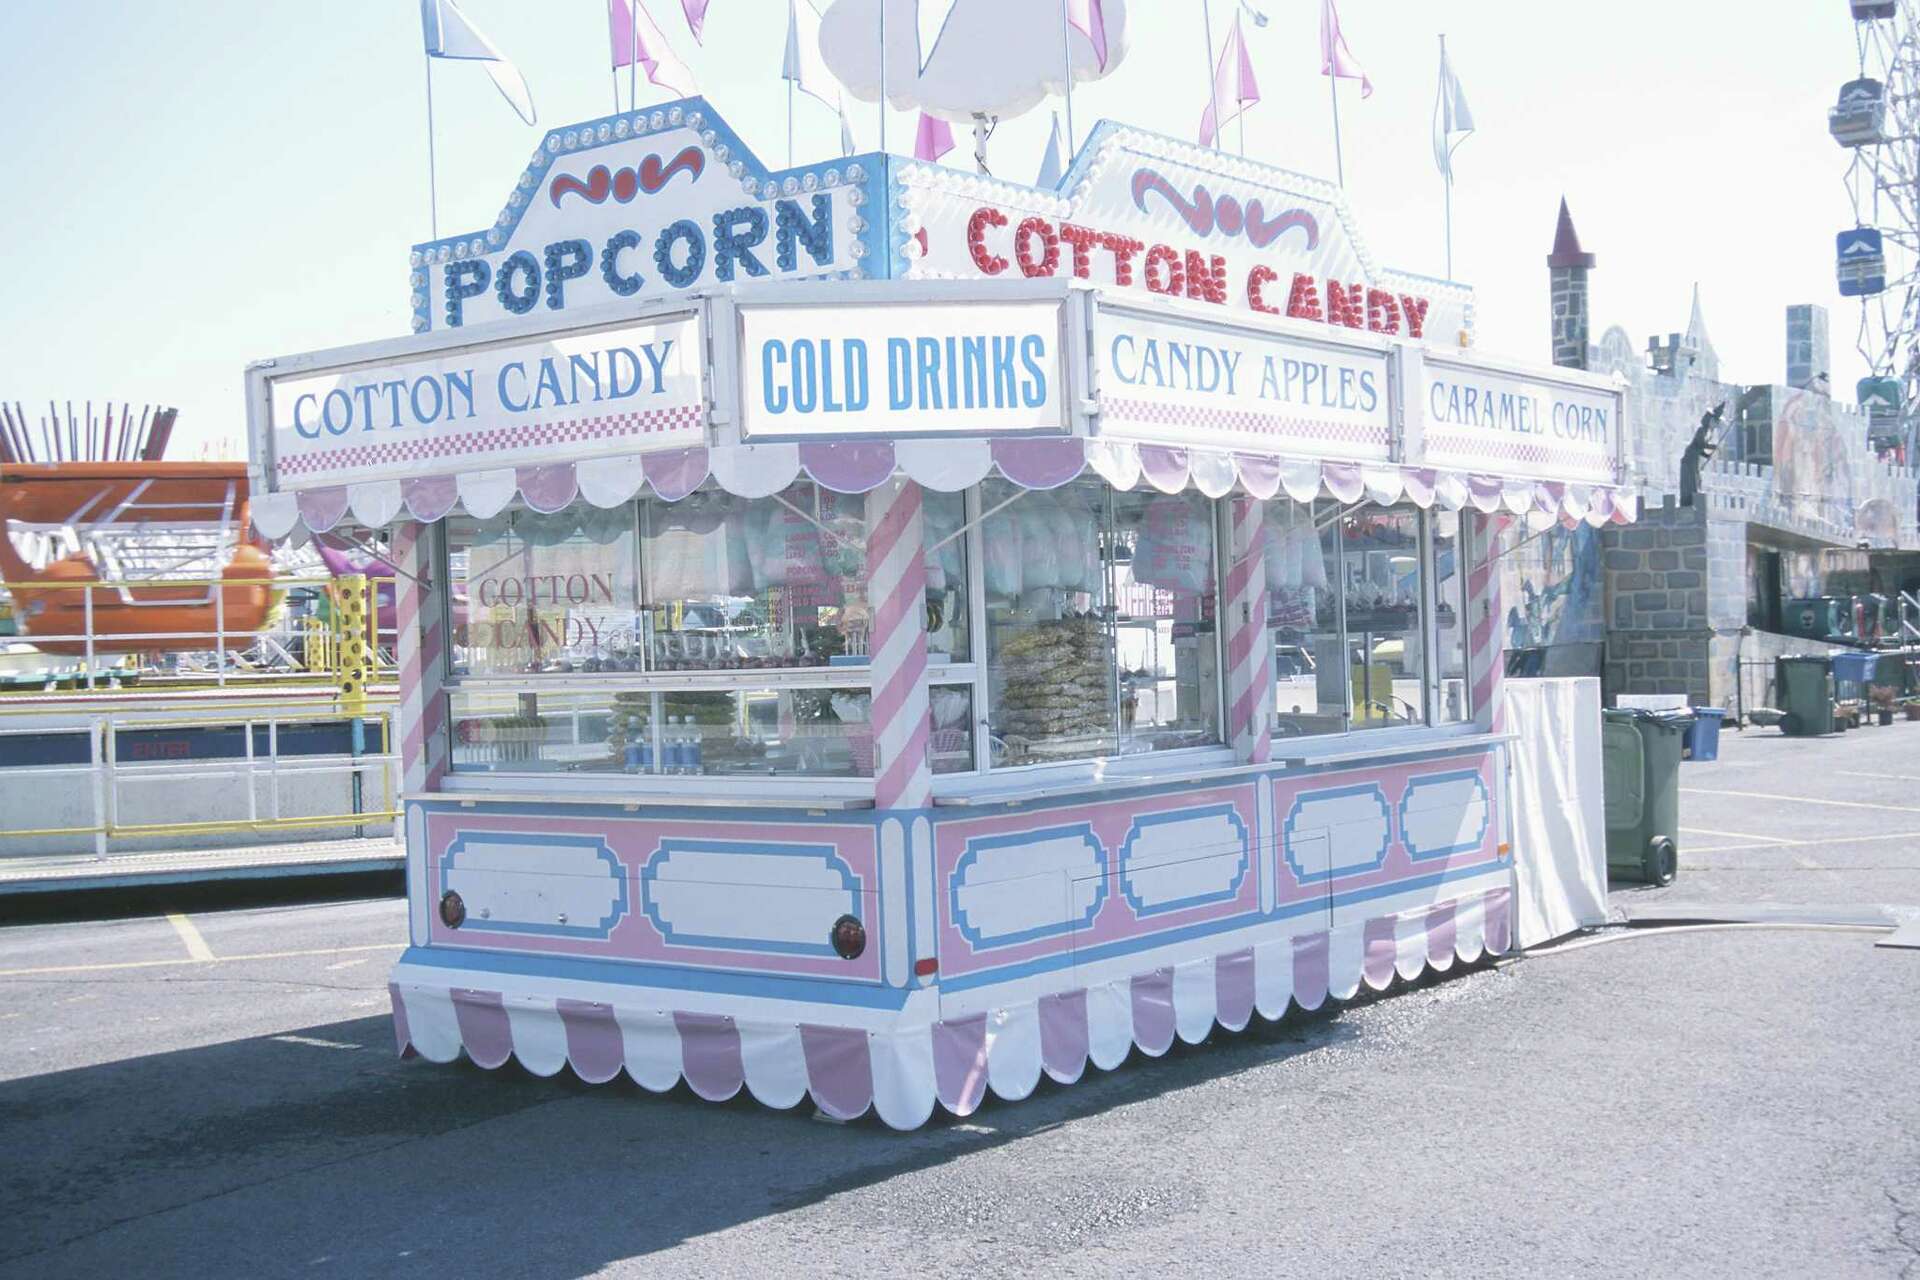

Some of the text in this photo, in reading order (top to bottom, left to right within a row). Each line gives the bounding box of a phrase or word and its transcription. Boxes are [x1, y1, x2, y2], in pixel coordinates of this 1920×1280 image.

[445, 194, 834, 327] POPCORN
[968, 207, 1430, 338] COTTON CANDY
[293, 341, 674, 439] COTTON CANDY
[762, 334, 1048, 414] COLD DRINKS
[1111, 333, 1379, 413] CANDY APPLES
[1429, 381, 1609, 444] CARAMEL CORN
[478, 573, 613, 608] COTTON
[496, 616, 605, 648] CANDY
